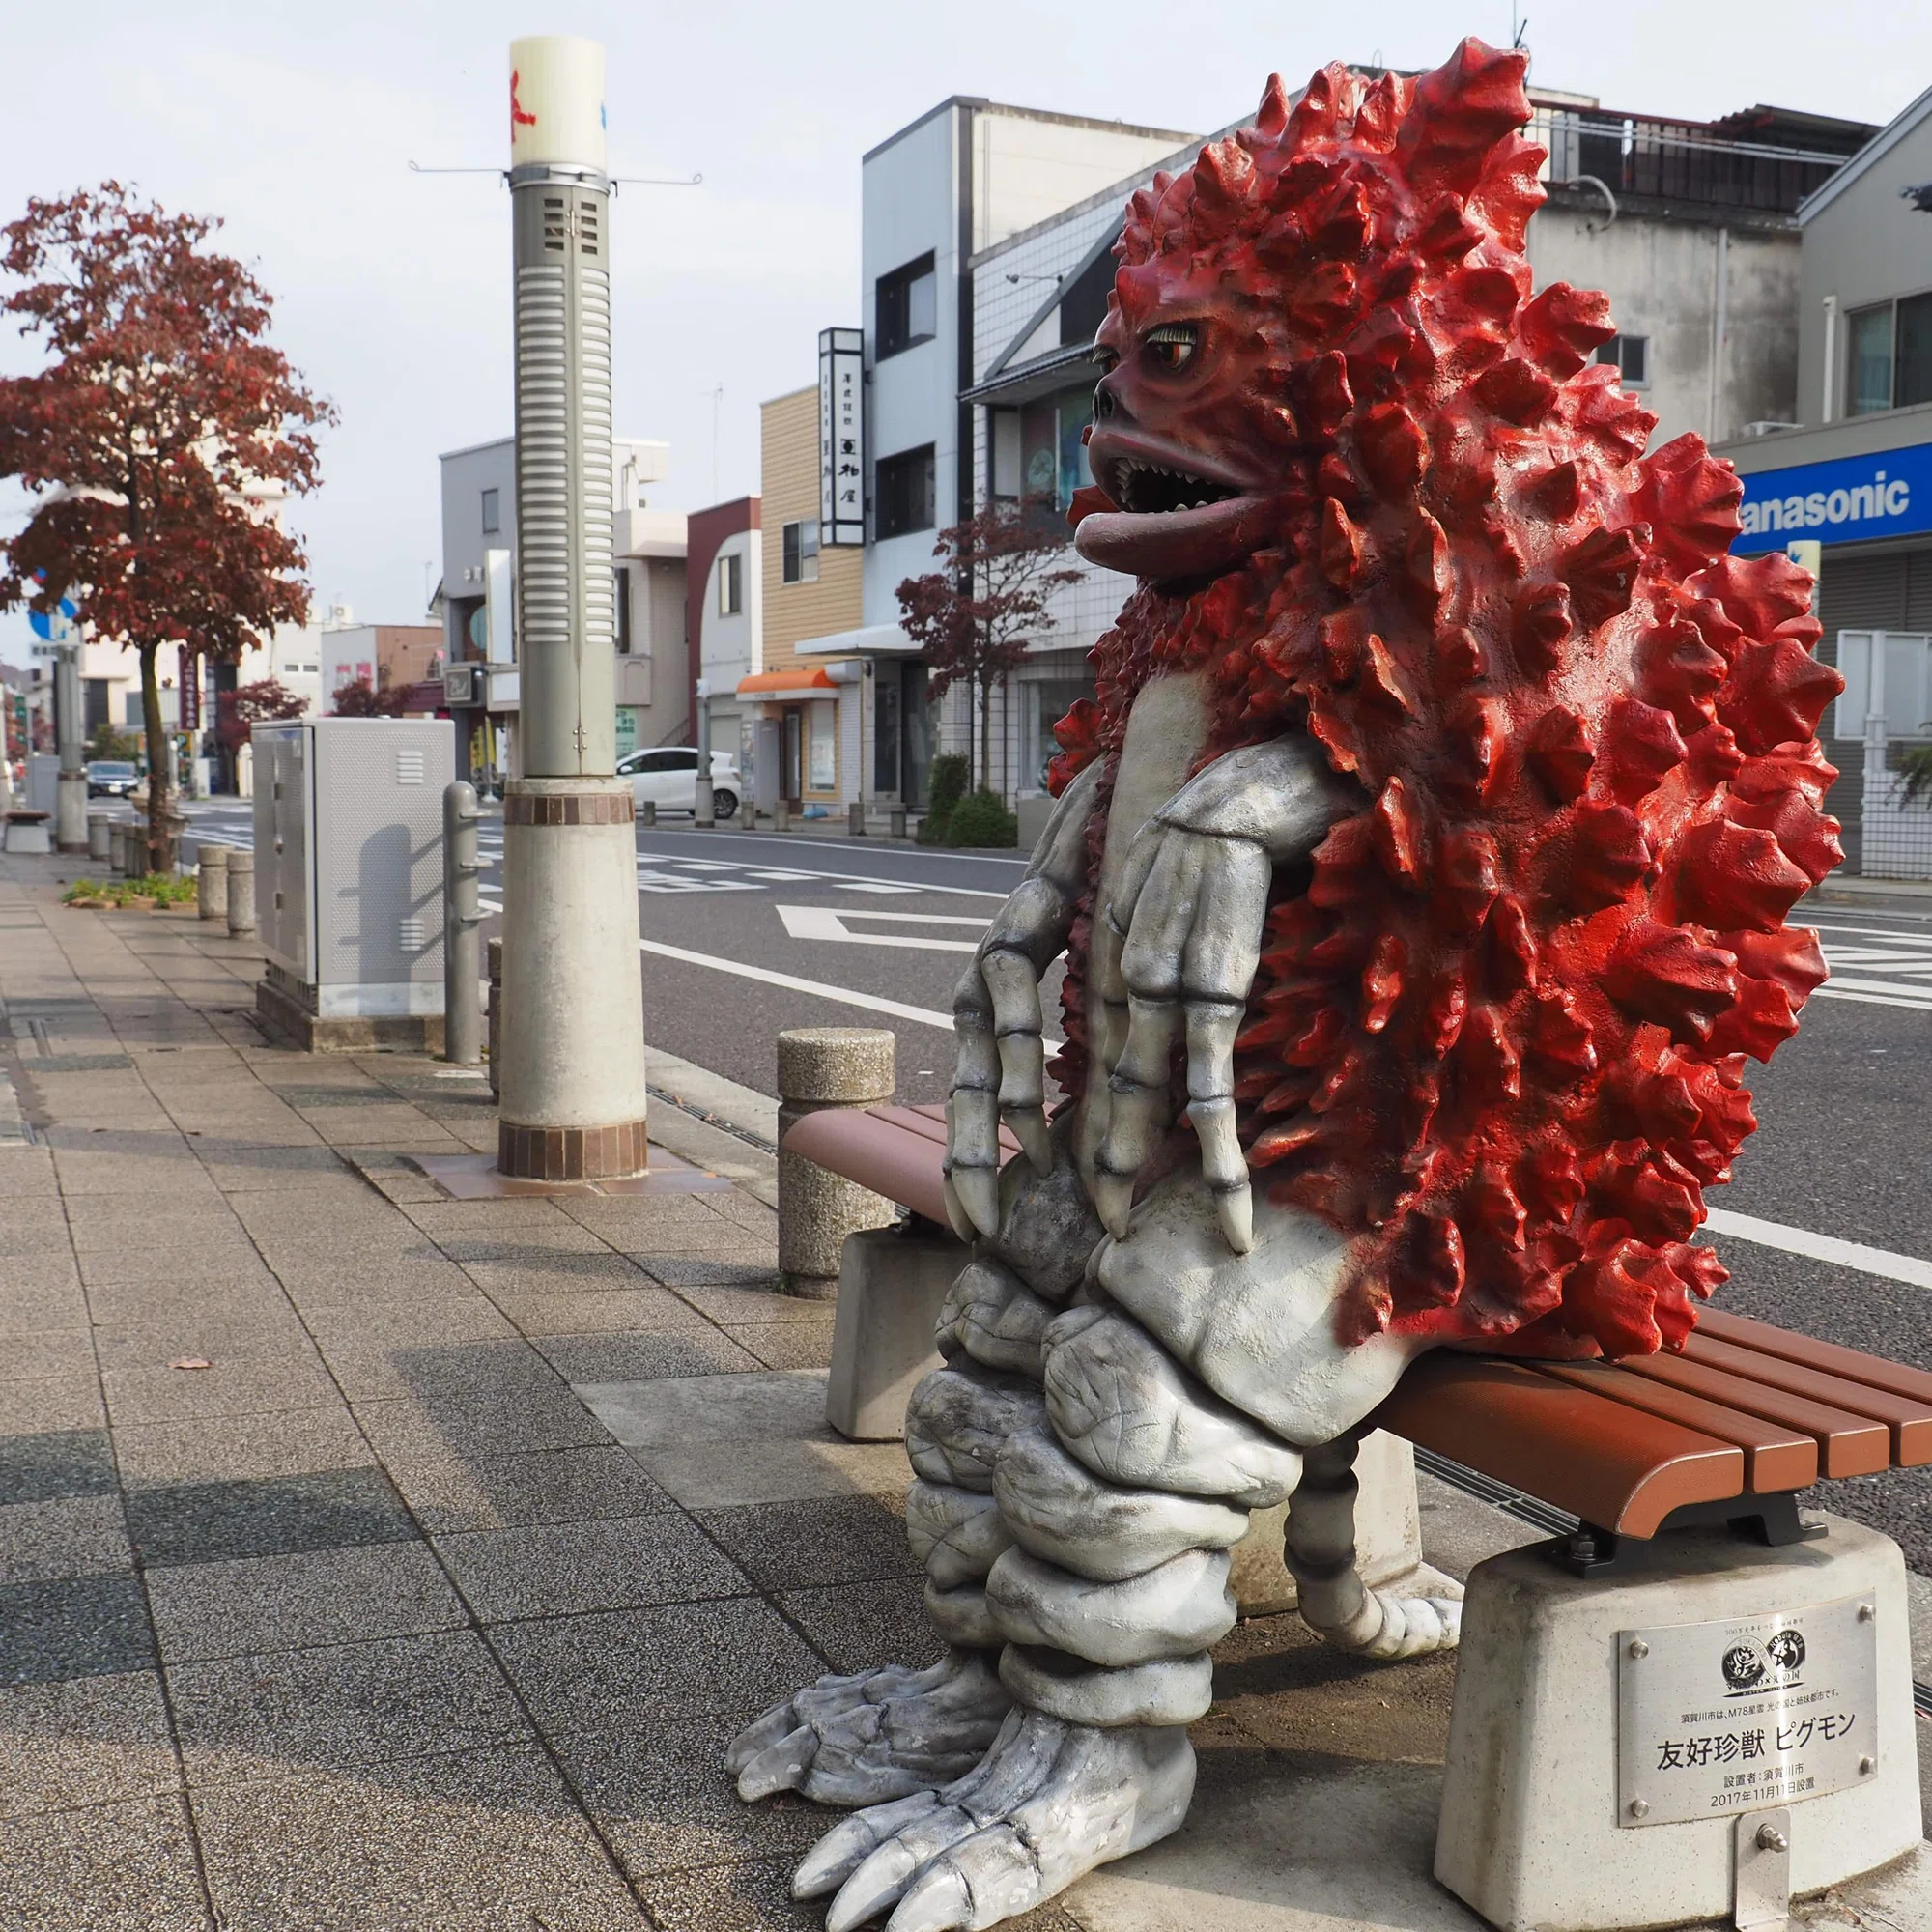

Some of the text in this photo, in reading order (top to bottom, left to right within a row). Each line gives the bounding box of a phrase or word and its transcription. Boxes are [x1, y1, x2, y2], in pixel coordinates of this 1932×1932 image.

[1740, 470, 1910, 535] anasonic
[1657, 1713, 1856, 1770] 友好珍獣 ピグモン
